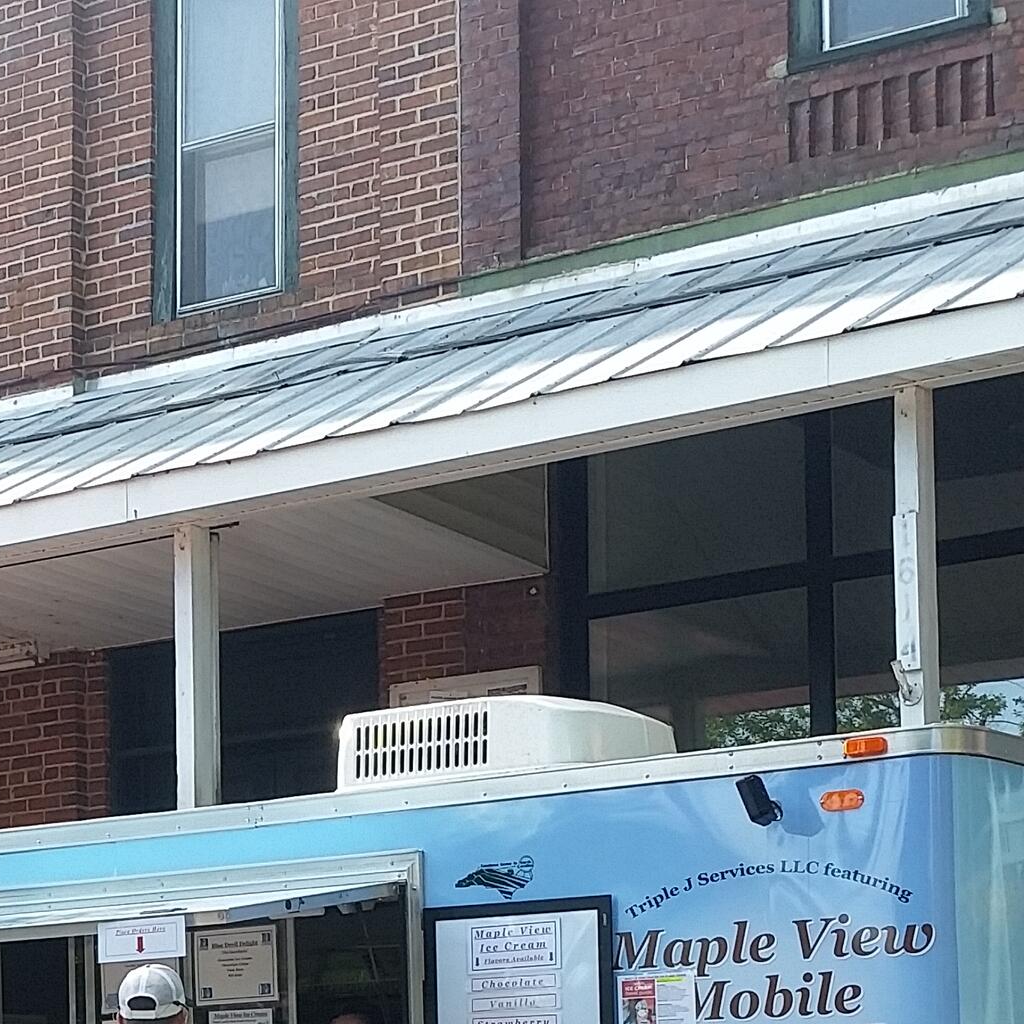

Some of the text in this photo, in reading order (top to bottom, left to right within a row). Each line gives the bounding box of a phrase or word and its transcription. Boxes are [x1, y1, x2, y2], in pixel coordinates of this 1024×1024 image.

[625, 860, 913, 919] Triple J Services LLC featuring
[474, 925, 553, 940] Maple View
[480, 941, 547, 953] Ice Cream
[613, 913, 935, 977] Maple View
[481, 978, 544, 989] Chocolate
[489, 998, 536, 1008] Vanilla
